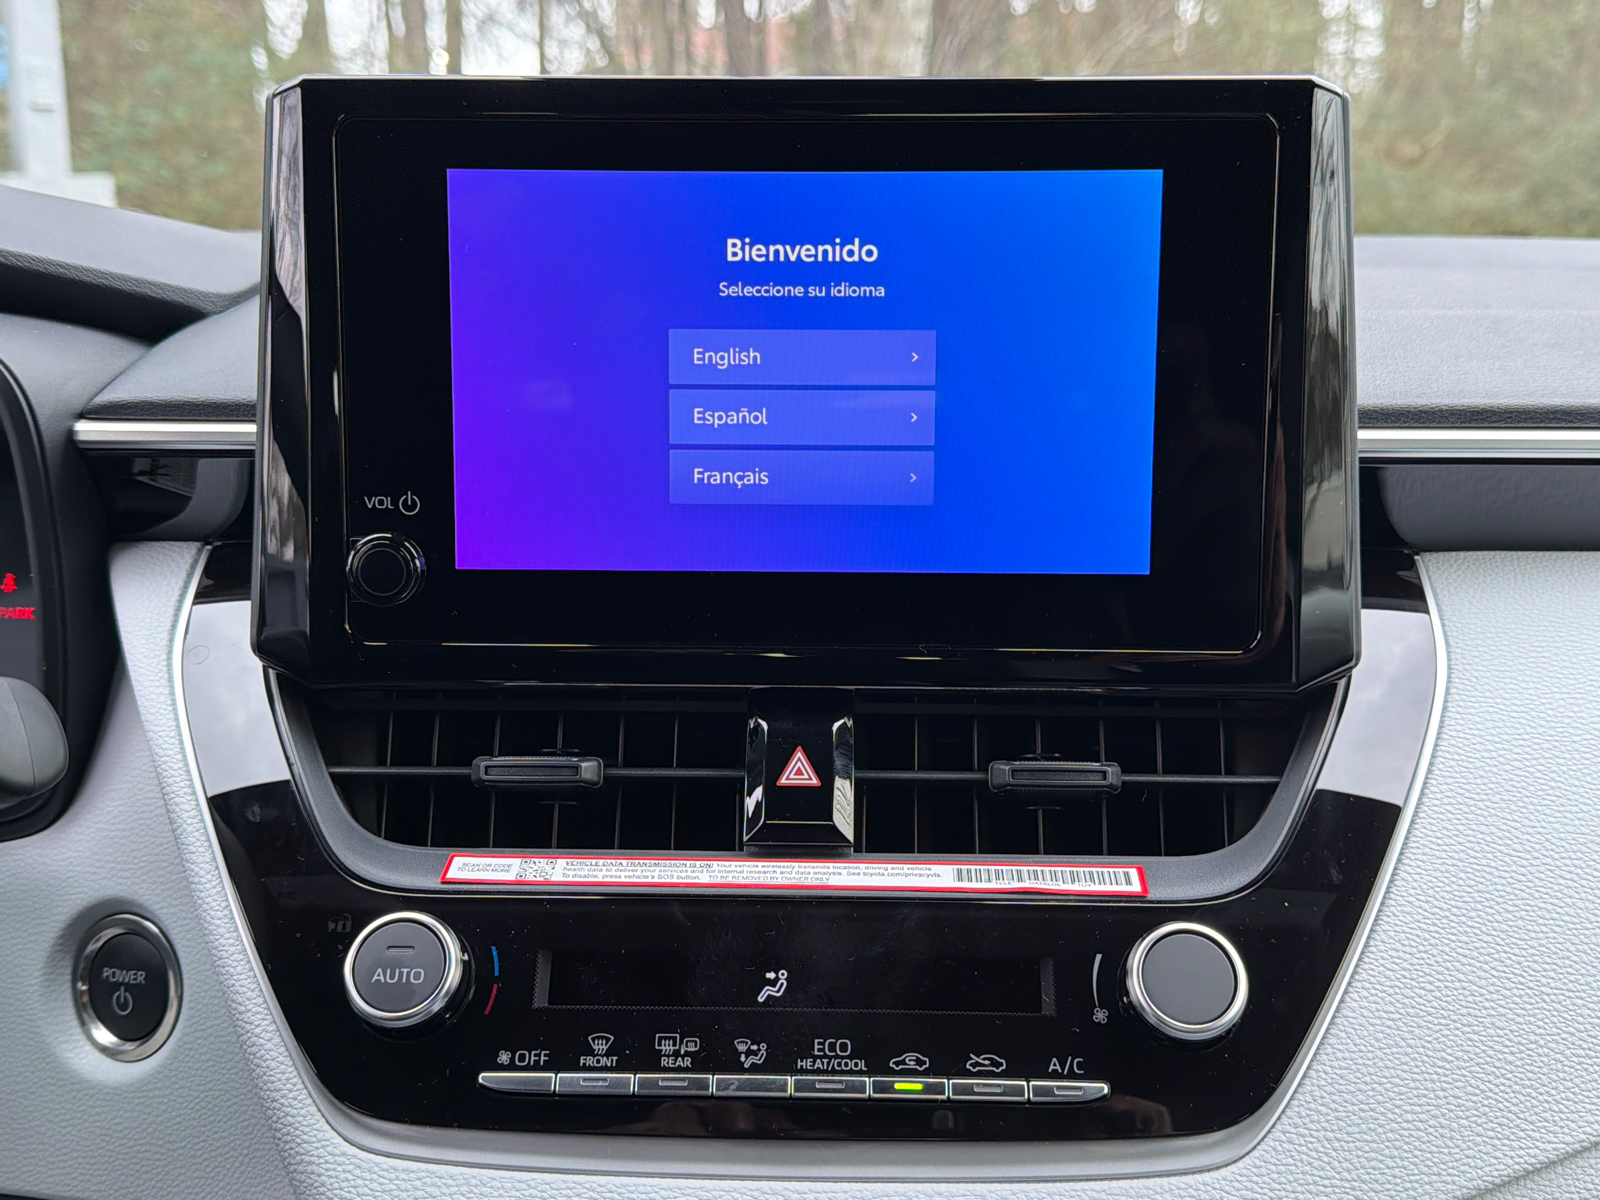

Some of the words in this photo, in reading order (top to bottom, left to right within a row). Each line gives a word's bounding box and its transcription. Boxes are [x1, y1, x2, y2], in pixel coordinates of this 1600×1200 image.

[726, 237, 879, 263] Bienvenido
[719, 281, 805, 297] Seleccione
[808, 285, 826, 297] su
[831, 281, 886, 298] idioma
[693, 347, 761, 370] English
[693, 407, 768, 428] Español
[693, 467, 769, 489] Français
[363, 496, 395, 509] VOL
[0, 606, 36, 620] PARK
[602, 860, 624, 868] DATA
[626, 861, 688, 869] TRANSMISSION
[602, 873, 622, 881] press
[102, 967, 146, 984] POWER
[371, 967, 425, 984] AUTO
[813, 1038, 852, 1056] ECO
[514, 1049, 550, 1066] OFF
[579, 1055, 618, 1067] FRONT
[660, 1056, 692, 1068] REAR
[797, 1056, 868, 1072] HEAT/COOL
[1048, 1055, 1085, 1075] A/C
